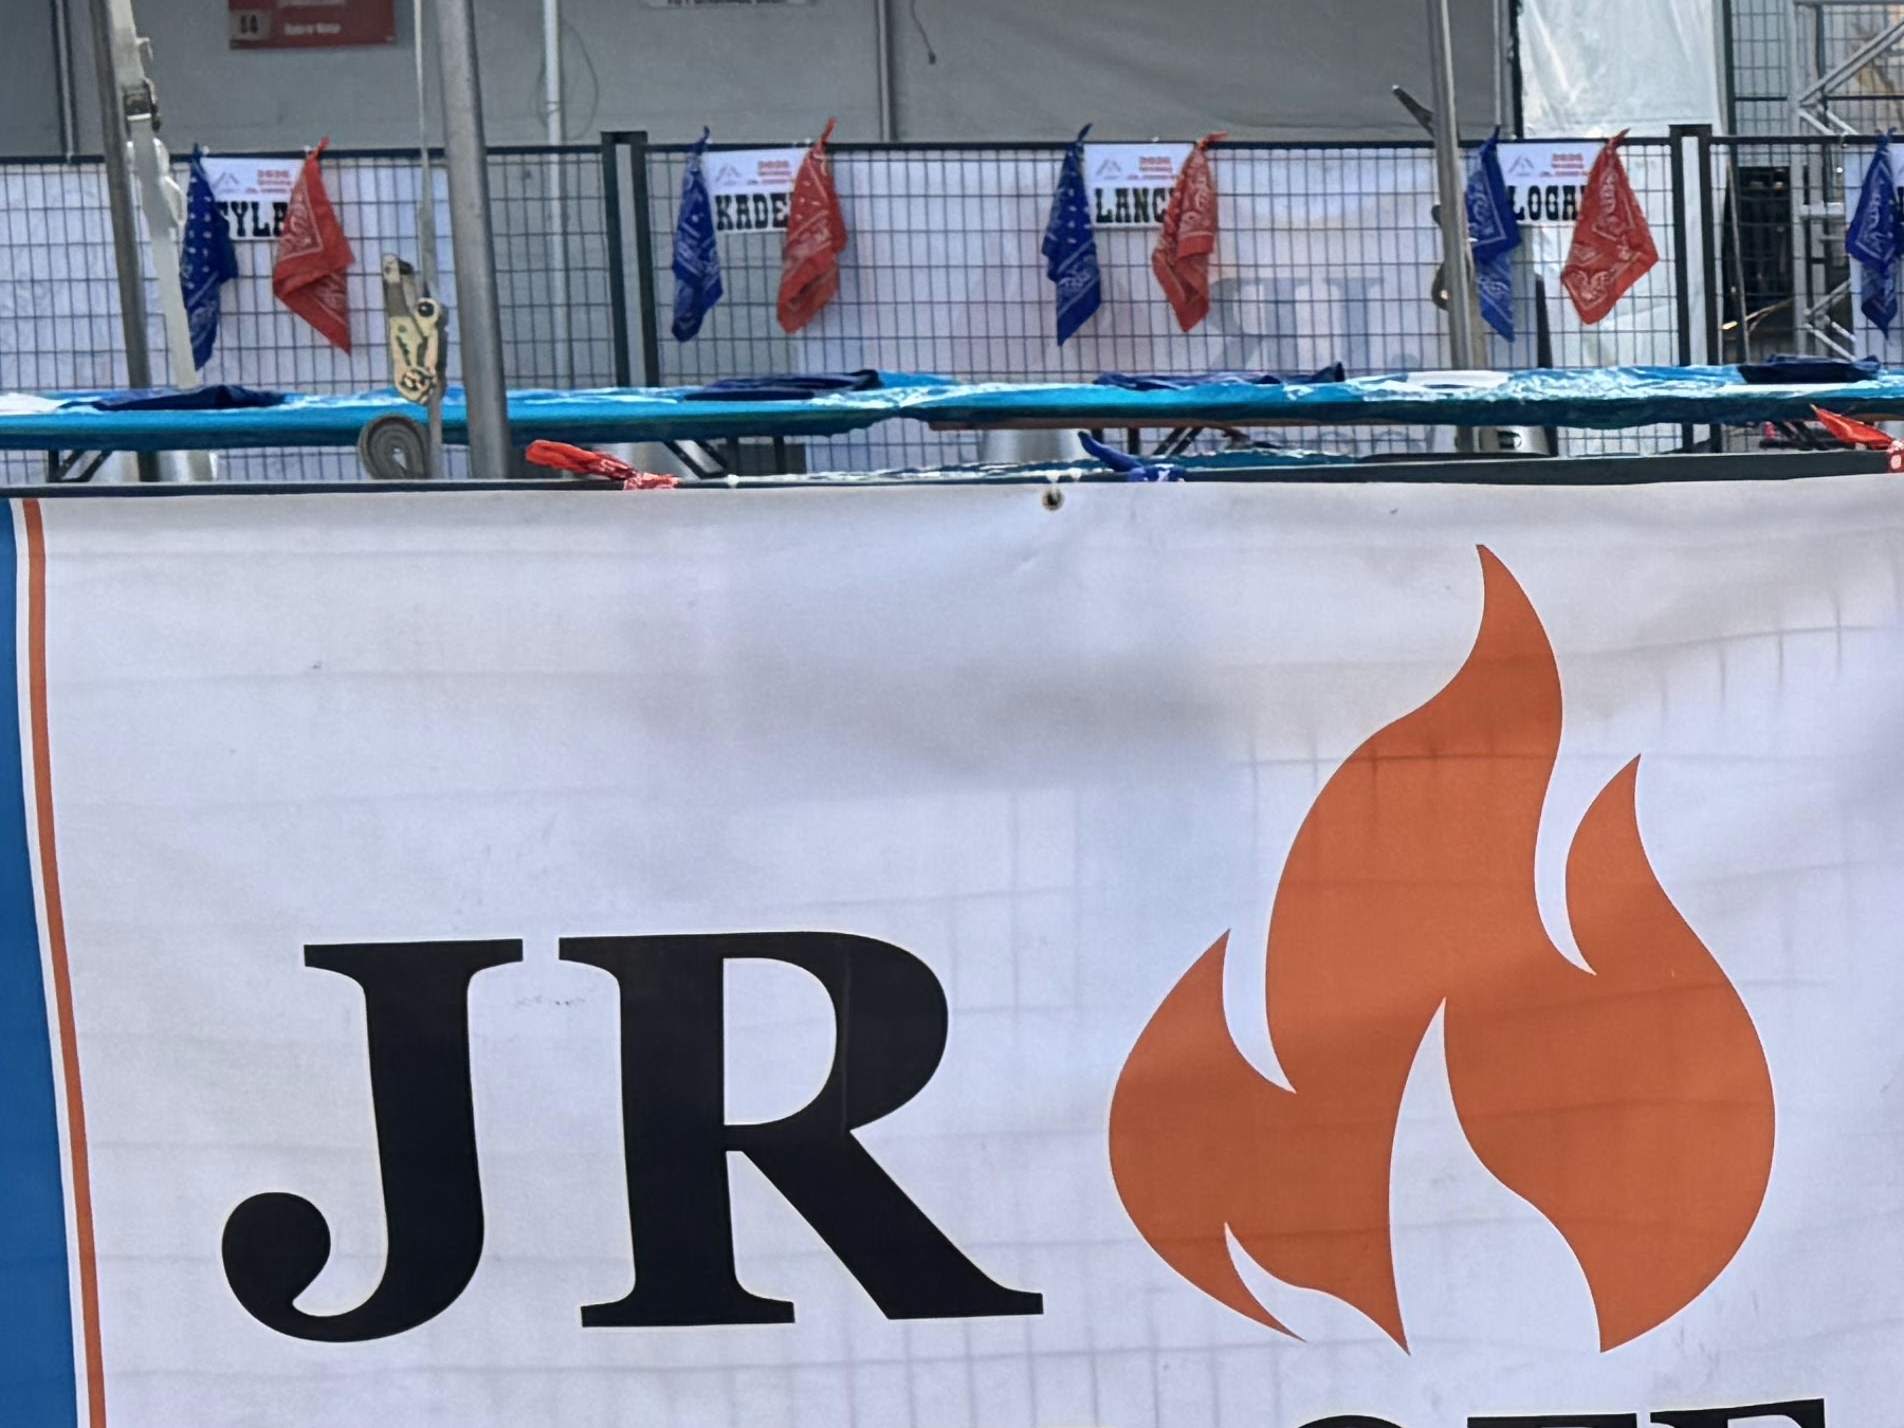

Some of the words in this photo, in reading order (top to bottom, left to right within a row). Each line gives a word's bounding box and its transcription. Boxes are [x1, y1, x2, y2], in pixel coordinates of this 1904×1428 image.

[715, 192, 792, 231] KADE
[1095, 187, 1173, 223] LANC
[1507, 185, 1587, 221] LOGA
[222, 932, 1043, 1342] JR
